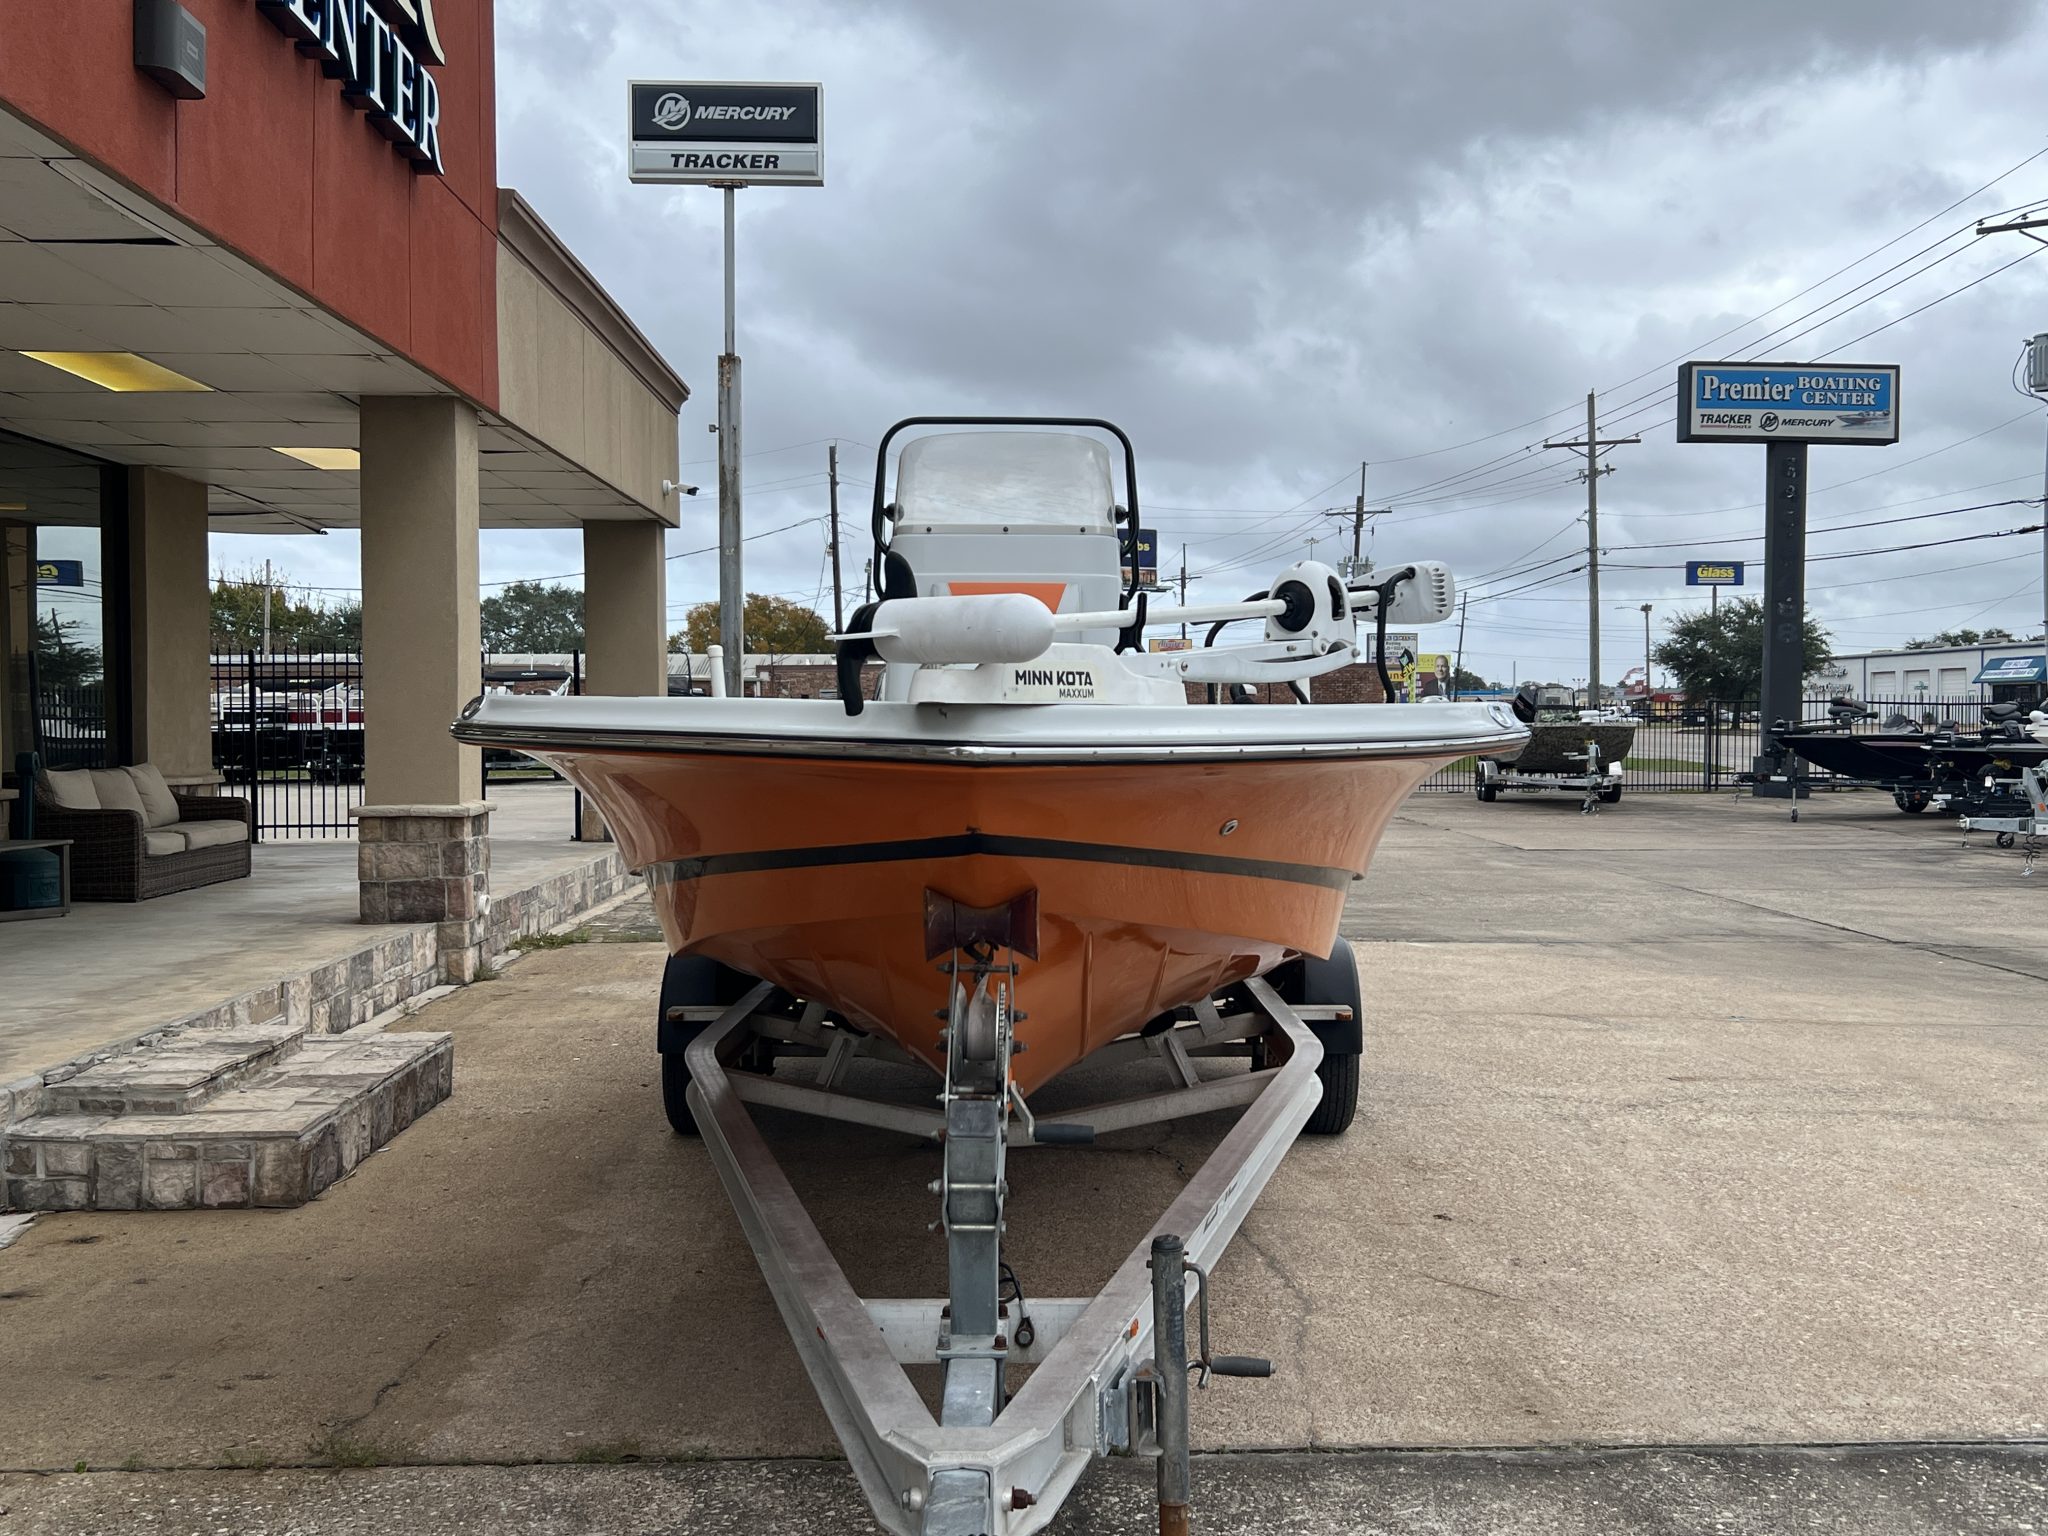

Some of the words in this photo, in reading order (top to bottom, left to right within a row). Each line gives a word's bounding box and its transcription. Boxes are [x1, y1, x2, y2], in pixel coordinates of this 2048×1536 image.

[695, 105, 796, 121] MERCURY
[671, 153, 779, 169] TRACKER
[1702, 375, 1794, 401] Premier
[1797, 376, 1882, 391] BOATING
[1801, 391, 1876, 405] CENTER
[1700, 413, 1752, 424] TRACKER
[1781, 418, 1836, 427] MERCURY
[1697, 567, 1735, 578] Glass
[1015, 669, 1053, 686] MINN
[1056, 670, 1093, 686] KOTA
[1059, 688, 1094, 698] MAXXUM
